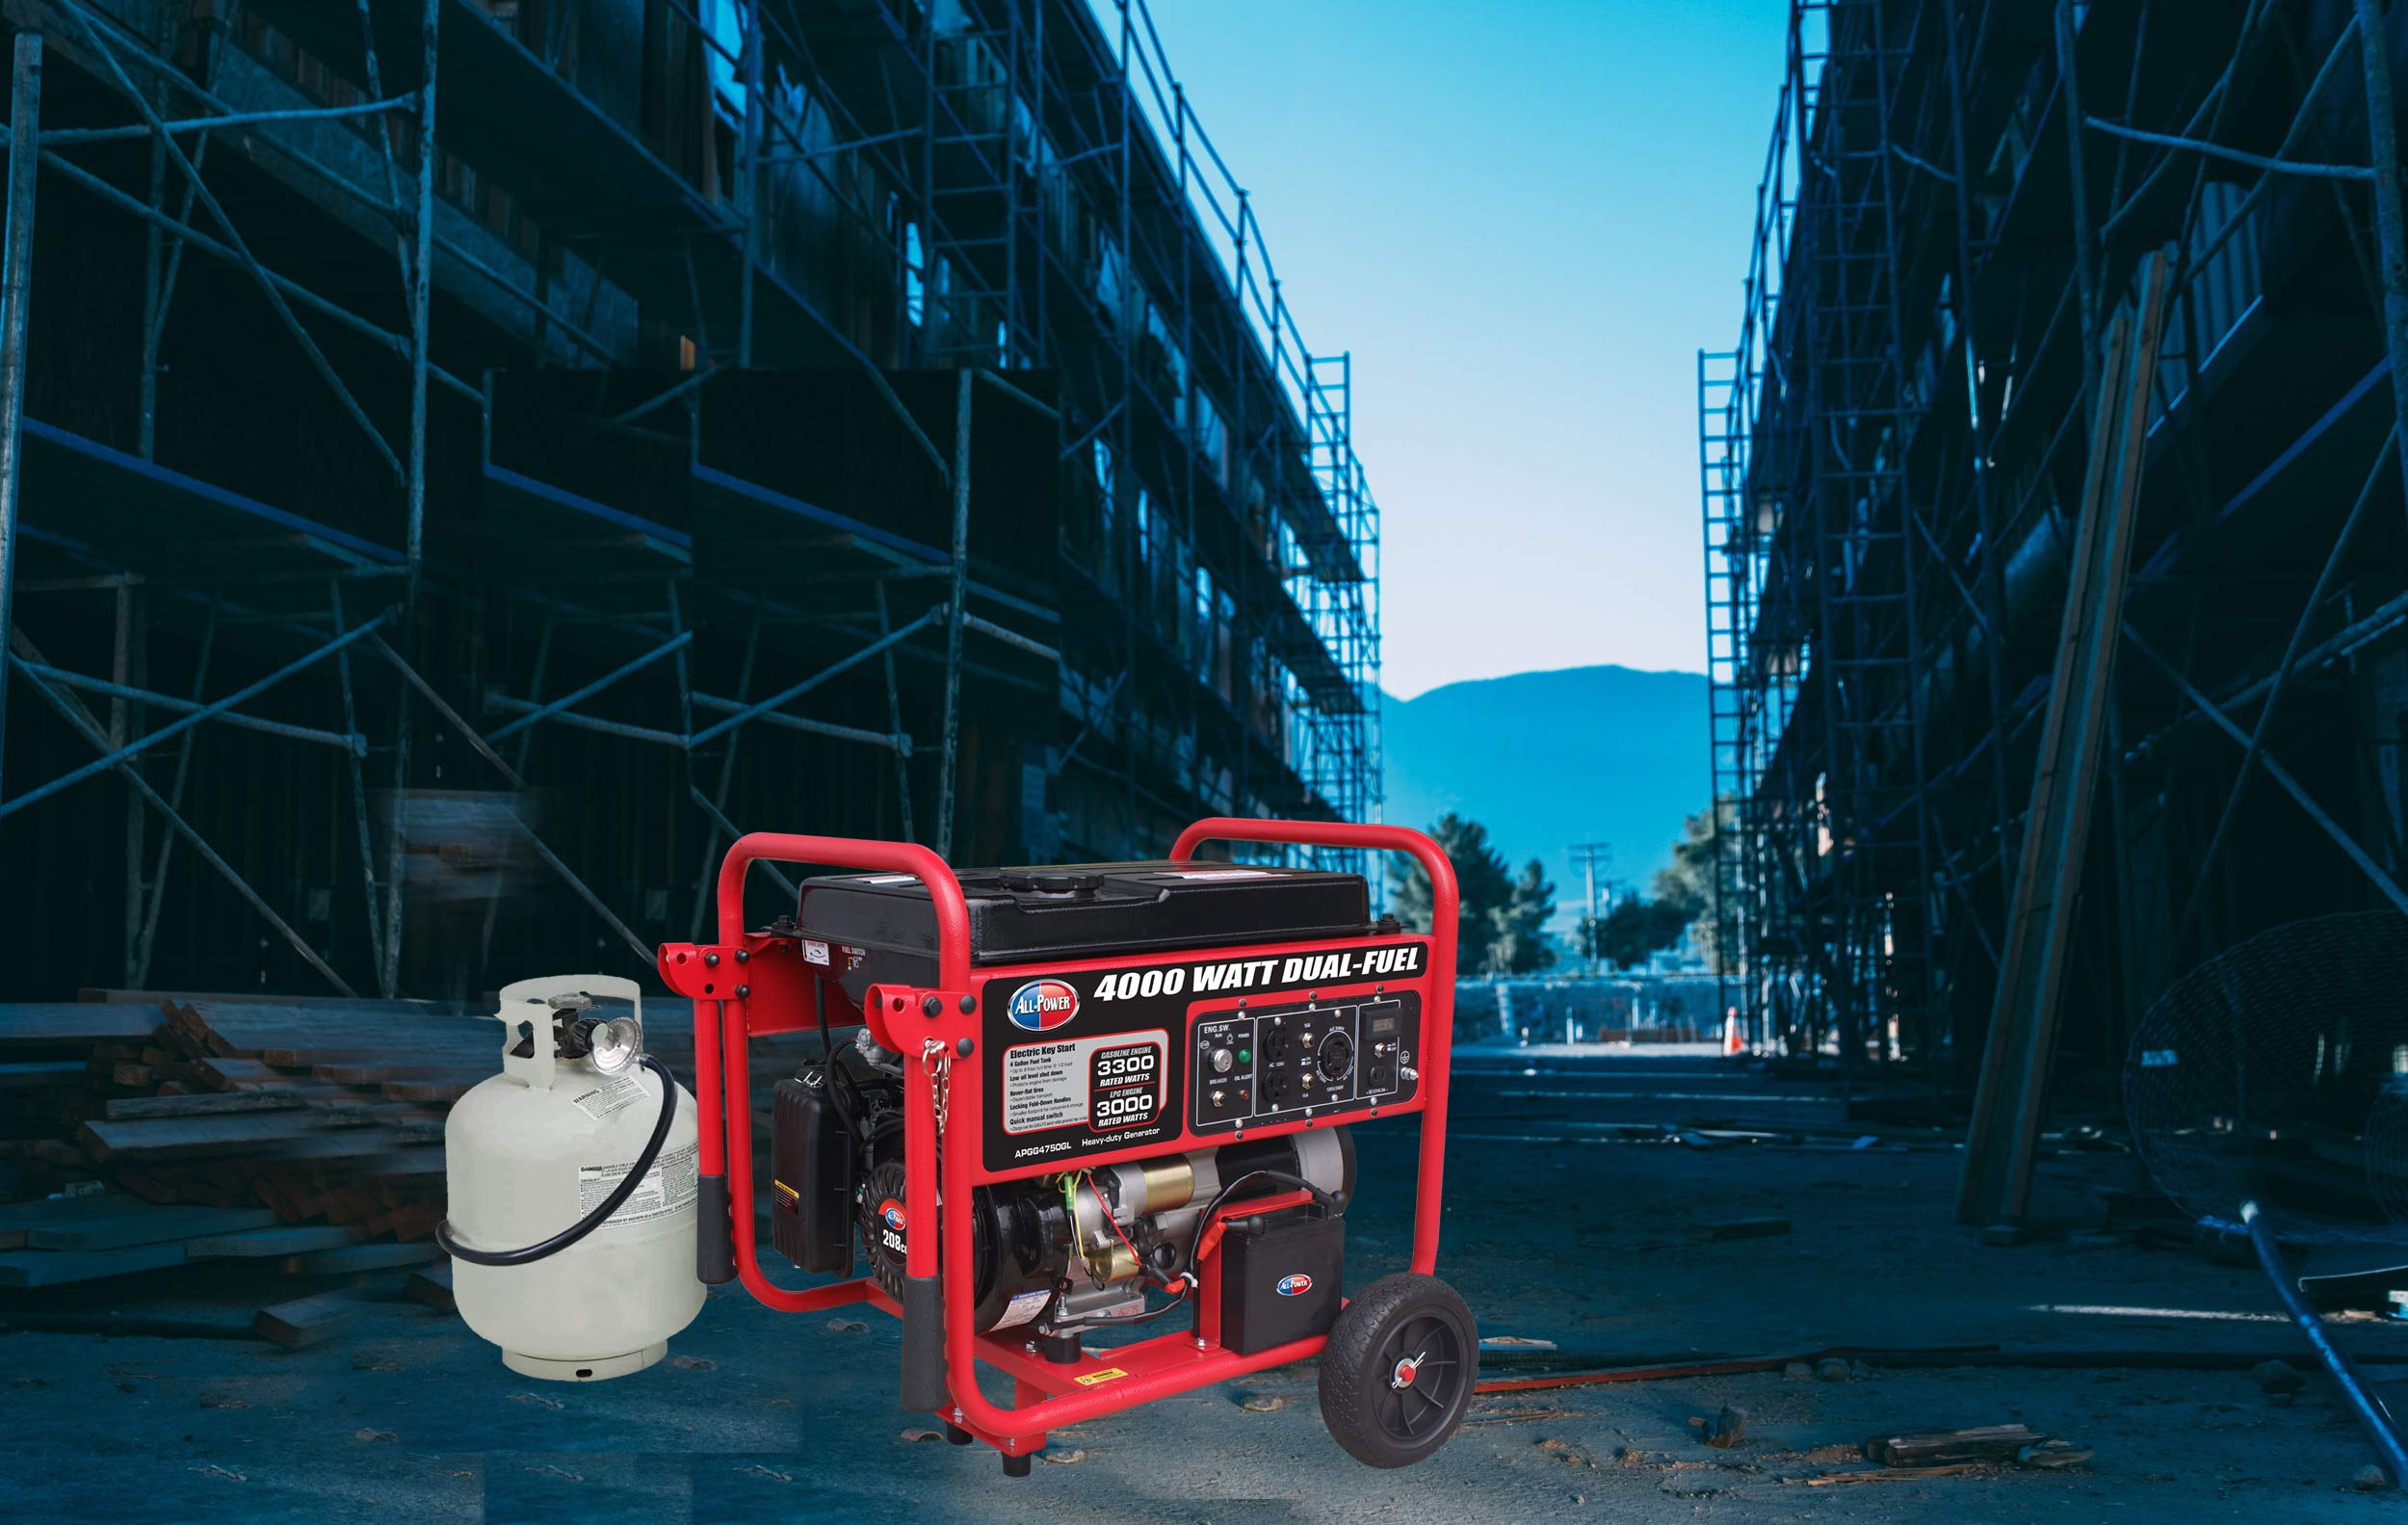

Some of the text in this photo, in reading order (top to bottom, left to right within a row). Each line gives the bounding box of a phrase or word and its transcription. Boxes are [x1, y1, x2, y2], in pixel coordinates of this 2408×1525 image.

[851, 947, 866, 956] SWITCH
[1093, 947, 1419, 1002] 4000 WATT DUAL-FUEL
[1014, 993, 1071, 1015] ALL-POWER
[1204, 1024, 1231, 1034] ENG.SW.
[1010, 1043, 1075, 1059] Electric Key Start
[1101, 1046, 1152, 1060] GASOLINE ENGINE
[1097, 1055, 1154, 1076] 3300
[1100, 1073, 1150, 1087] RATED WATTS
[1122, 1087, 1143, 1096] ENGINE
[1096, 1094, 1153, 1117] 3000
[1026, 1114, 1045, 1122] manual
[1098, 1117, 1121, 1127] RATED
[1123, 1112, 1148, 1123] WATTS
[1082, 1128, 1161, 1146] Heavy-duty Generator
[1014, 1142, 1072, 1158] APGG4750GL
